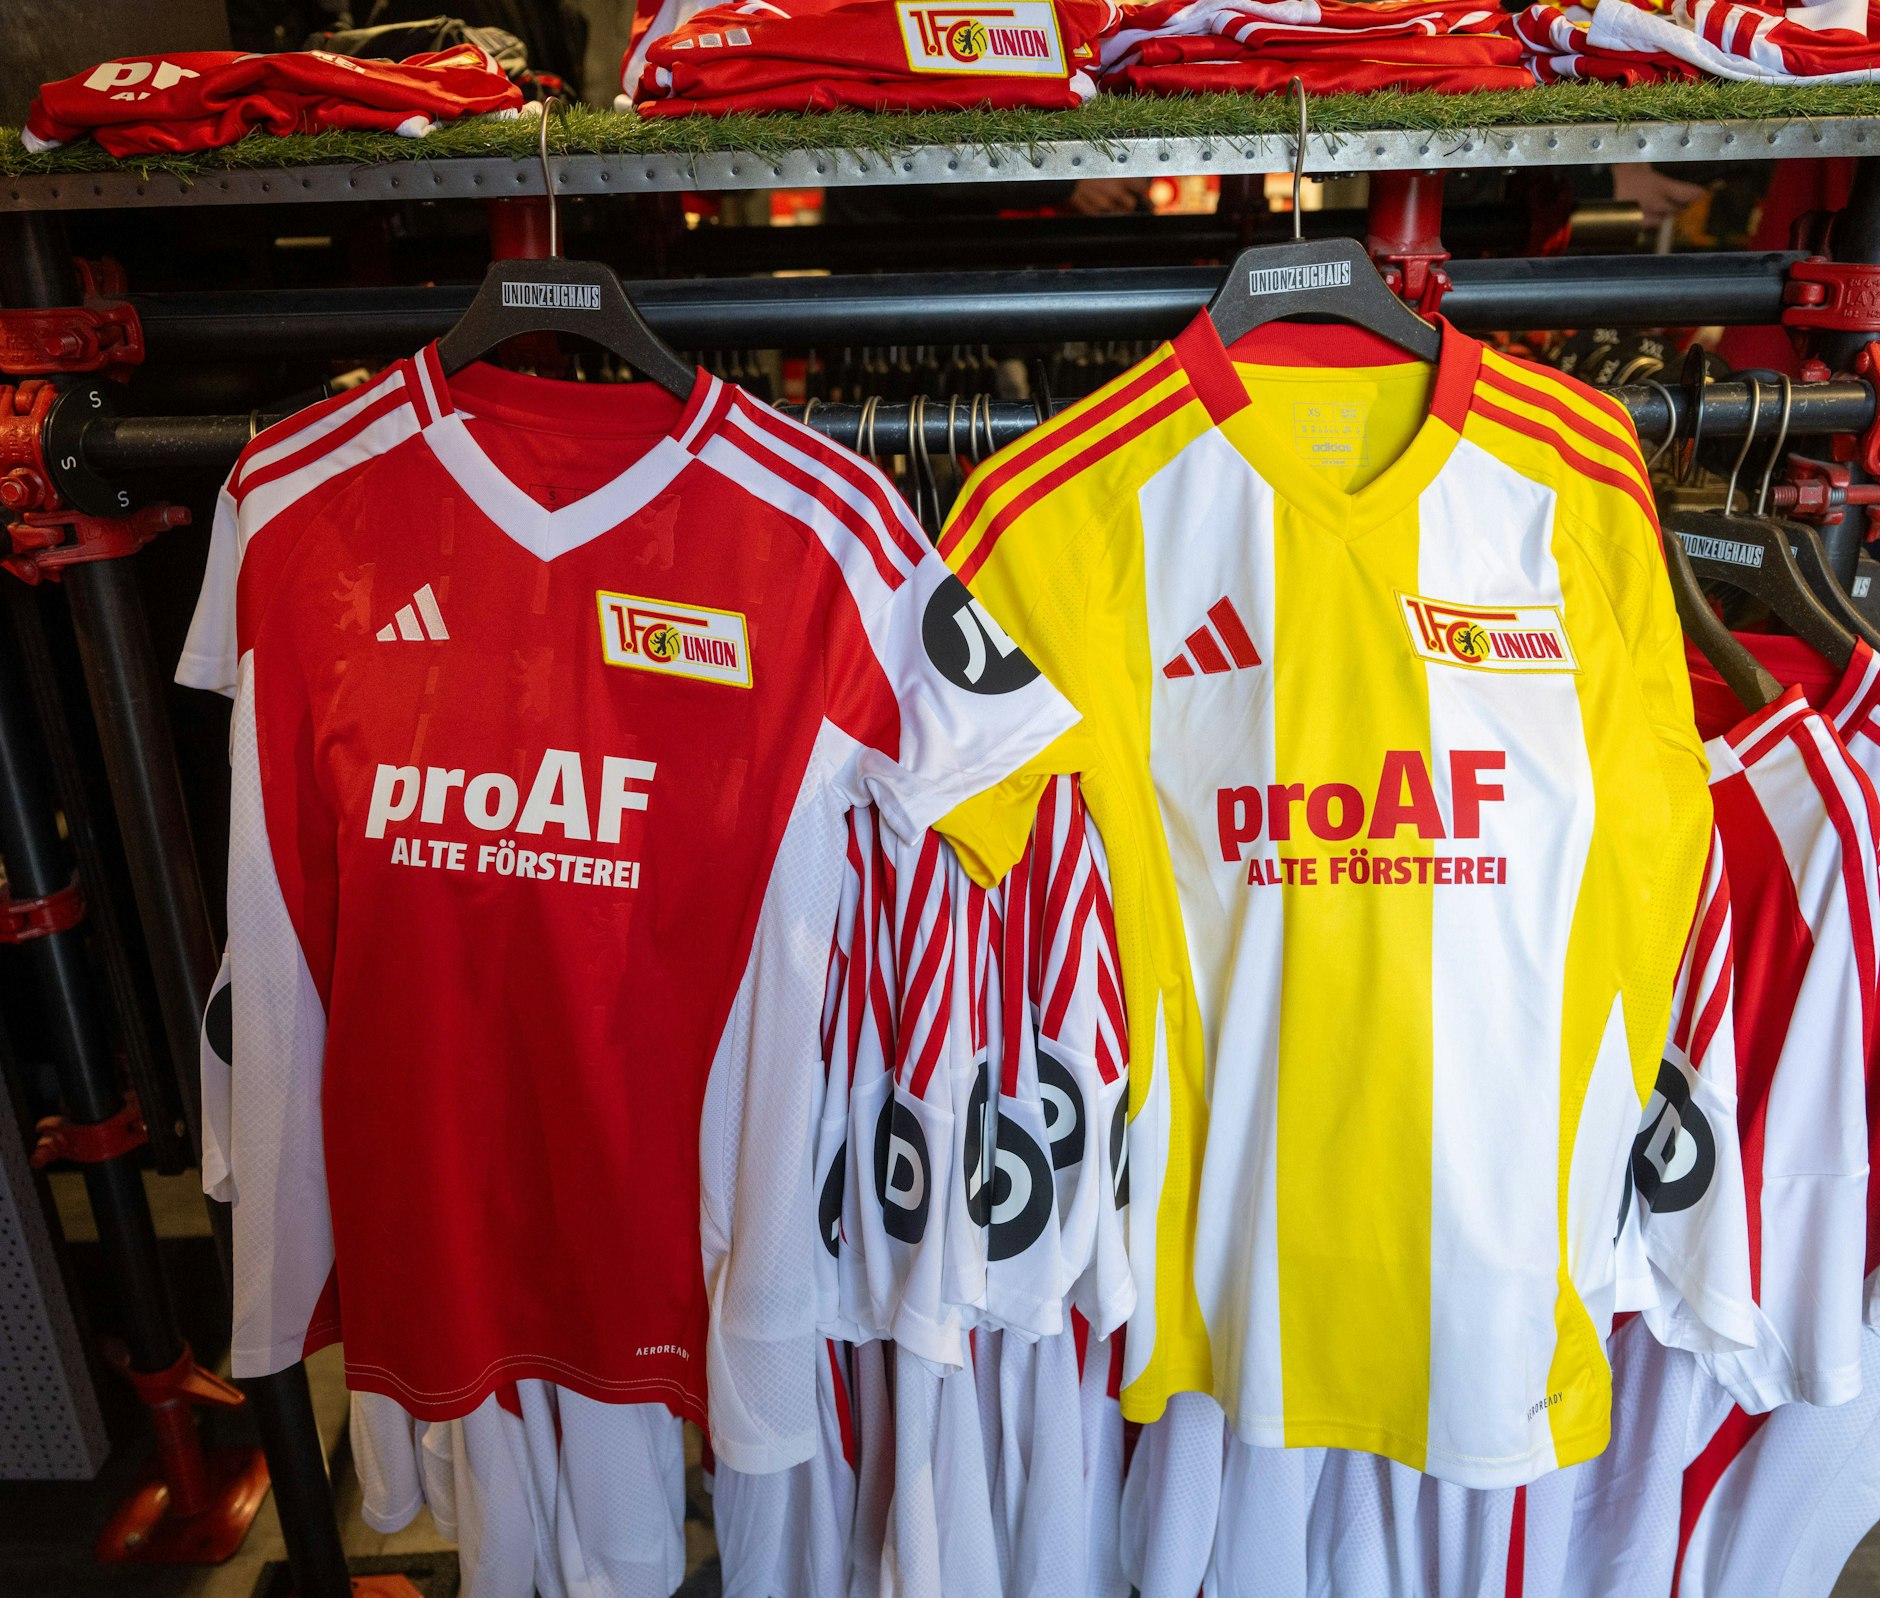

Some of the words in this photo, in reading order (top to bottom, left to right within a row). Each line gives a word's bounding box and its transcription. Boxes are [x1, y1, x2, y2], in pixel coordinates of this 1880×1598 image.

[988, 28, 1050, 58] UNION
[1251, 262, 1349, 293] UNIONZEUGHAUS
[504, 284, 599, 308] UNIONZEUGHAUS
[89, 391, 102, 408] S
[61, 456, 77, 470] S
[117, 491, 130, 507] S
[549, 491, 556, 500] S
[682, 635, 737, 668] UNION
[1489, 632, 1563, 659] UNION
[365, 748, 657, 844] proAF
[1217, 750, 1506, 862] proAF
[390, 837, 468, 871] ALTE
[477, 838, 640, 889] FÖRSTEREI
[1248, 858, 1317, 886] ALTE
[1330, 848, 1507, 885] FÖRSTEREI
[636, 1344, 689, 1361] AEROREADY
[1527, 1391, 1563, 1424] AEROREADY
